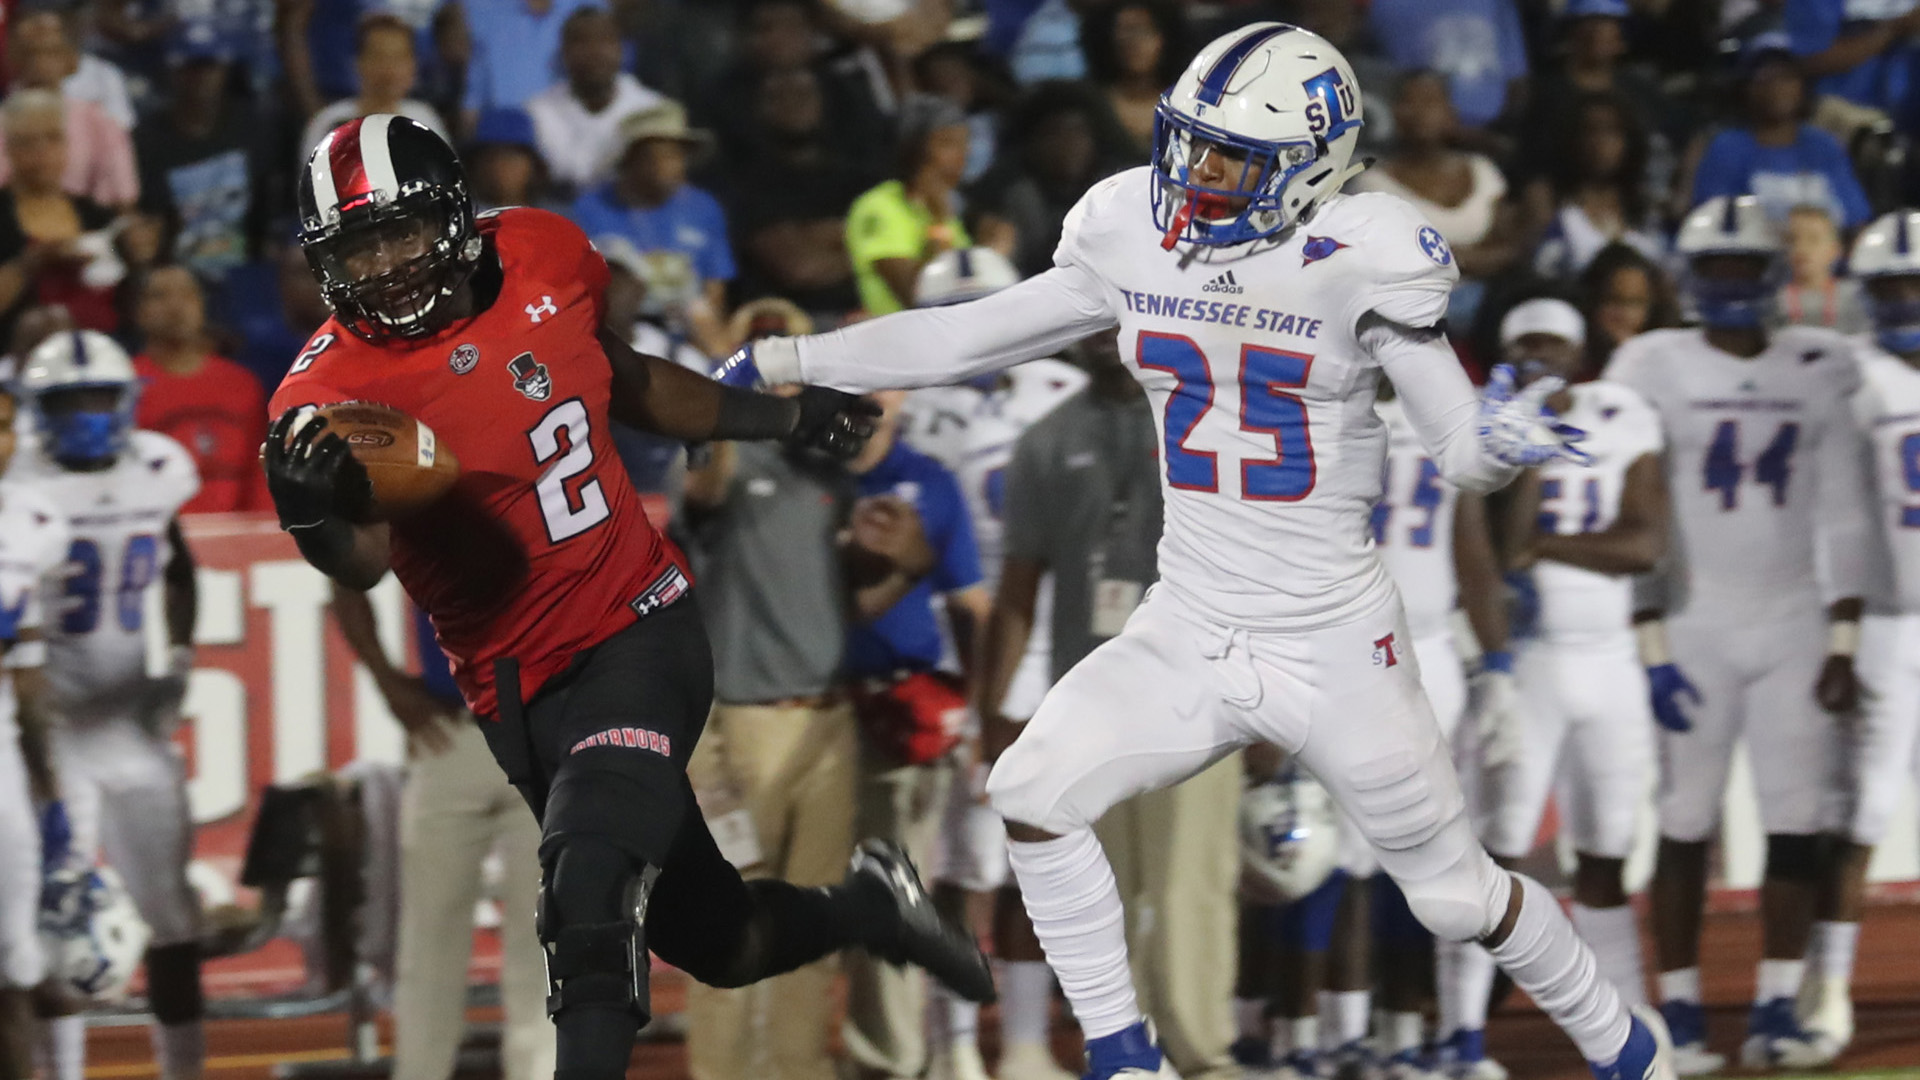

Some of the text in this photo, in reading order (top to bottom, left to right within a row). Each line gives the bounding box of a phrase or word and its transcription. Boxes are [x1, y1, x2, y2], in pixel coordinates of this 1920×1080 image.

[1120, 288, 1323, 339] TENNESSEE STATE
[1202, 283, 1244, 294] adidas
[290, 333, 335, 375] 2
[347, 432, 390, 446] GST
[1136, 329, 1317, 502] 25
[527, 396, 612, 545] 2
[1703, 420, 1801, 511] 44
